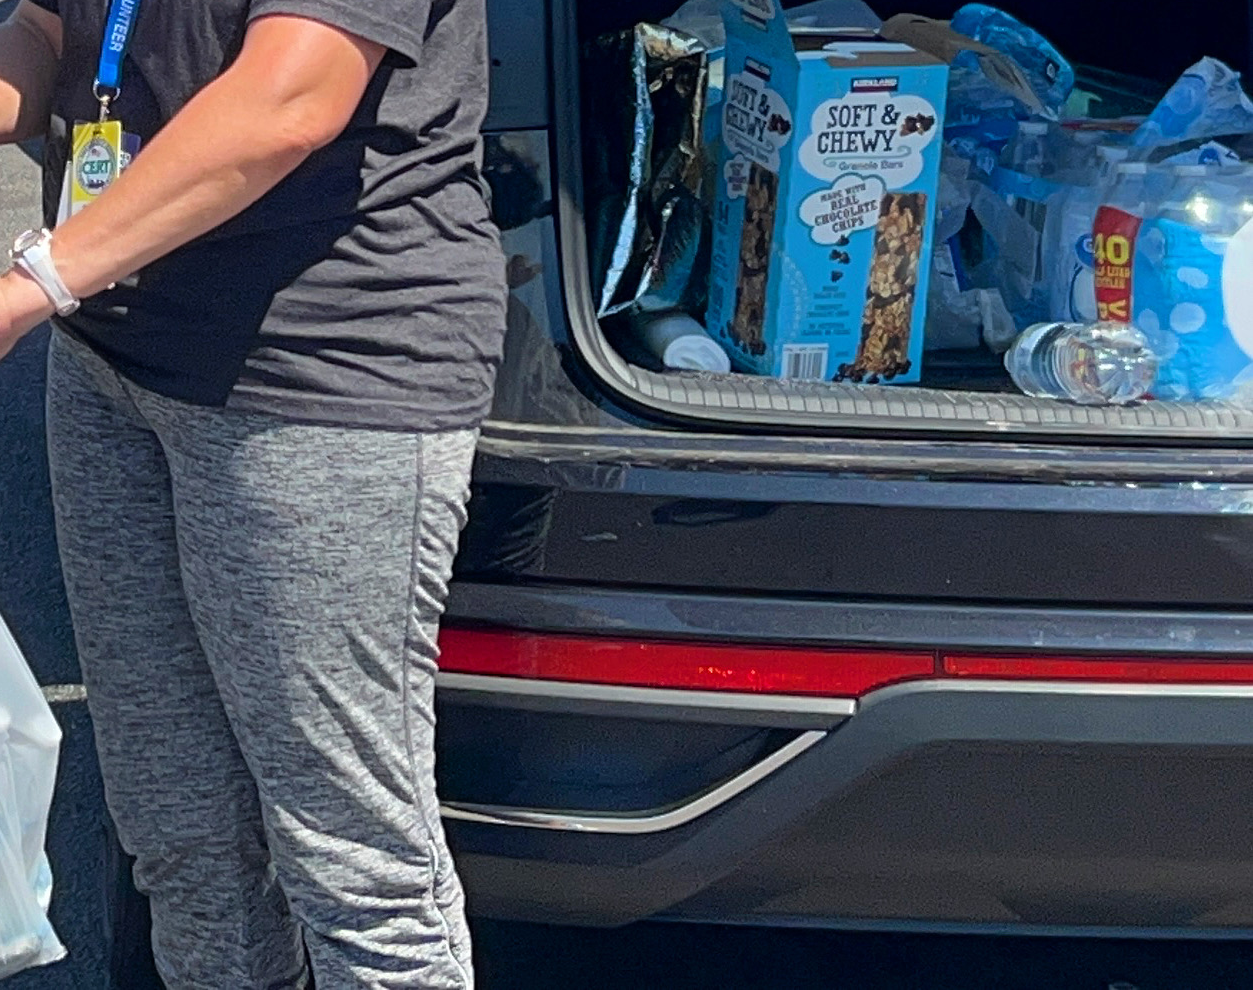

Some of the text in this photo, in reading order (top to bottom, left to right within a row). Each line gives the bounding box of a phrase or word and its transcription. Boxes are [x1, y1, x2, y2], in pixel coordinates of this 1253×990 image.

[826, 103, 901, 129] SOFT &
[817, 130, 897, 155] CHEWY
[82, 159, 111, 175] CERT
[838, 160, 904, 171] Granola Bars
[845, 183, 866, 195] WITH
[830, 196, 860, 211] REAL
[814, 199, 879, 227] CHOCOLATE
[832, 216, 865, 234] CHIPS
[1094, 232, 1130, 265] 40
